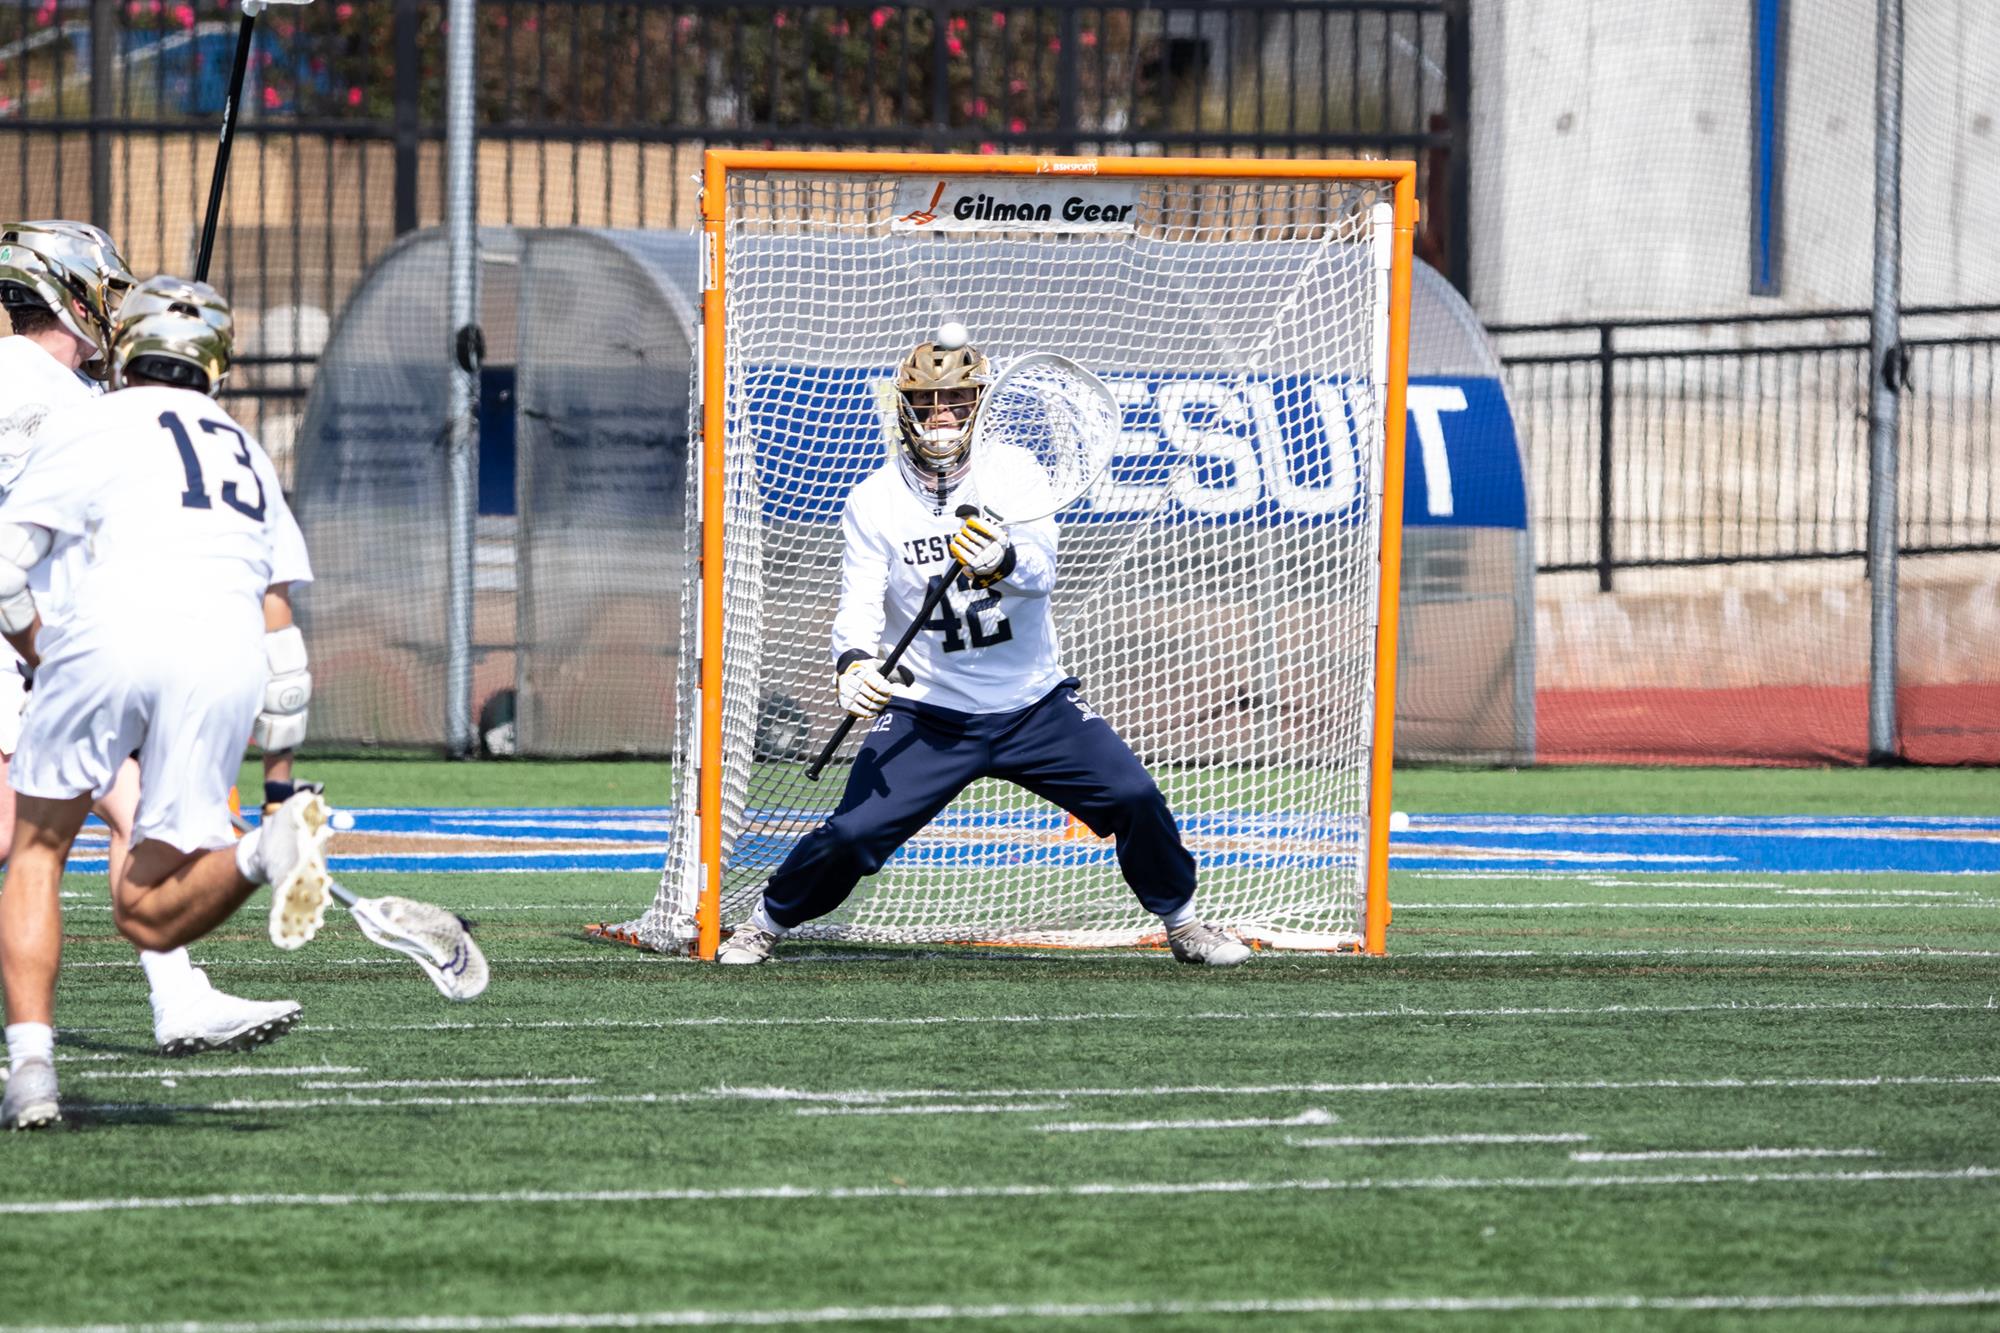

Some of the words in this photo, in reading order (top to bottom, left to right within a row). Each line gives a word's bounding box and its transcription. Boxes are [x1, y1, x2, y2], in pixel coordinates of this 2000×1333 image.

[953, 193, 1052, 222] Gilman
[1062, 196, 1133, 222] Gear
[158, 410, 266, 523] 13
[918, 572, 1013, 654] 42
